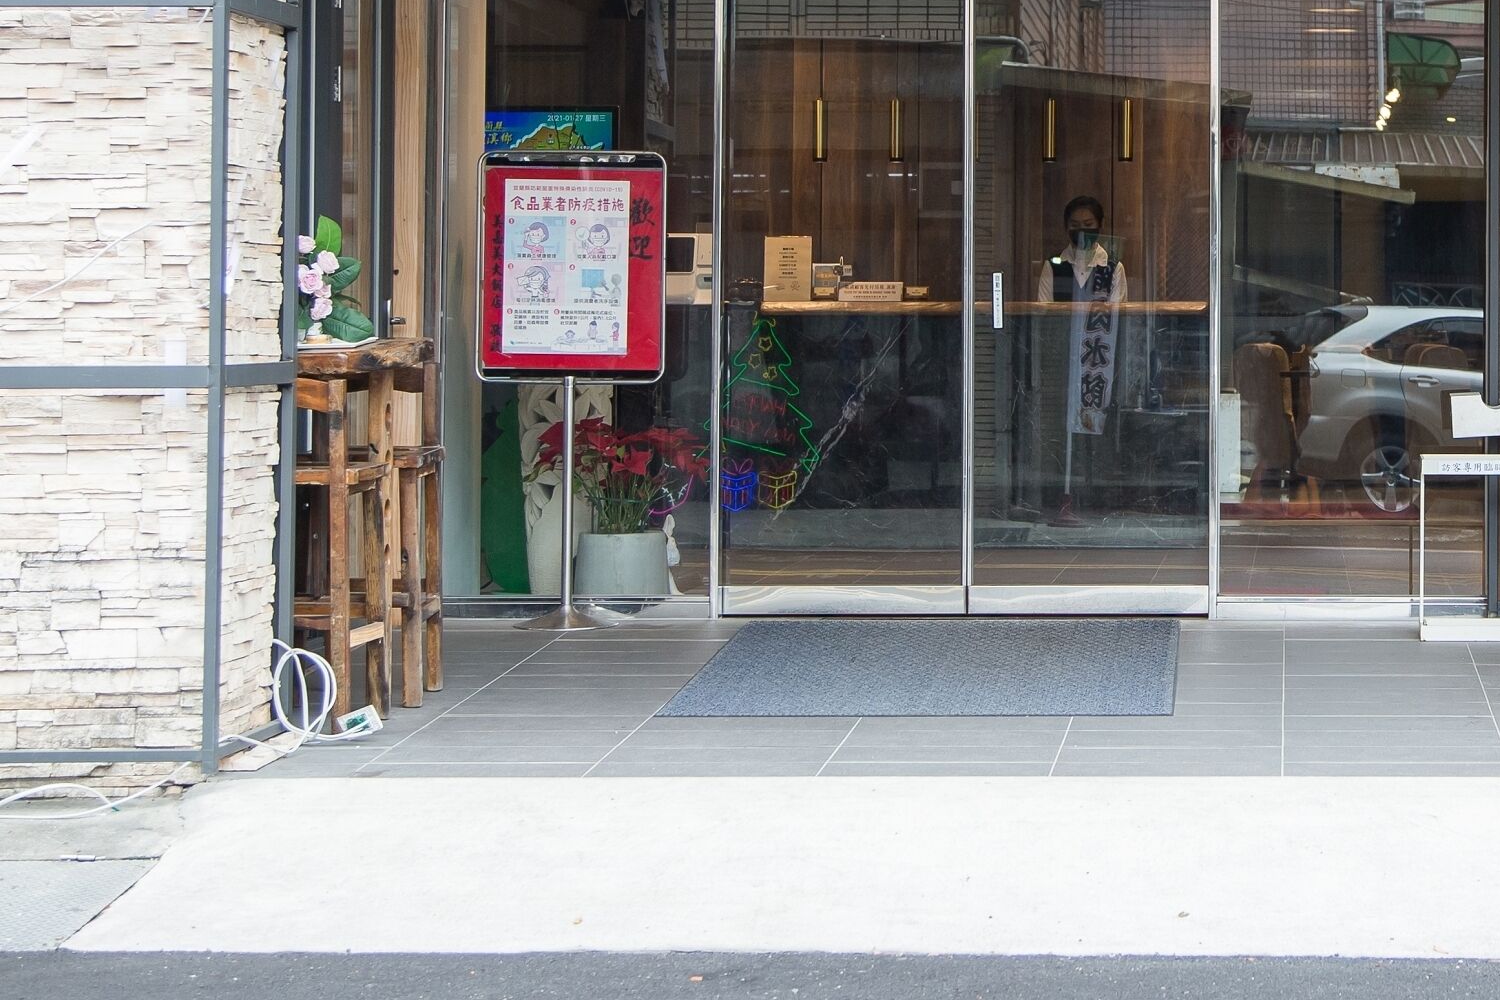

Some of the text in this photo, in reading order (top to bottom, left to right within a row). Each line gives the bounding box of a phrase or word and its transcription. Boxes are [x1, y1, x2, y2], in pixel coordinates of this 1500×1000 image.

[510, 195, 625, 212] 食品業者防疫措施
